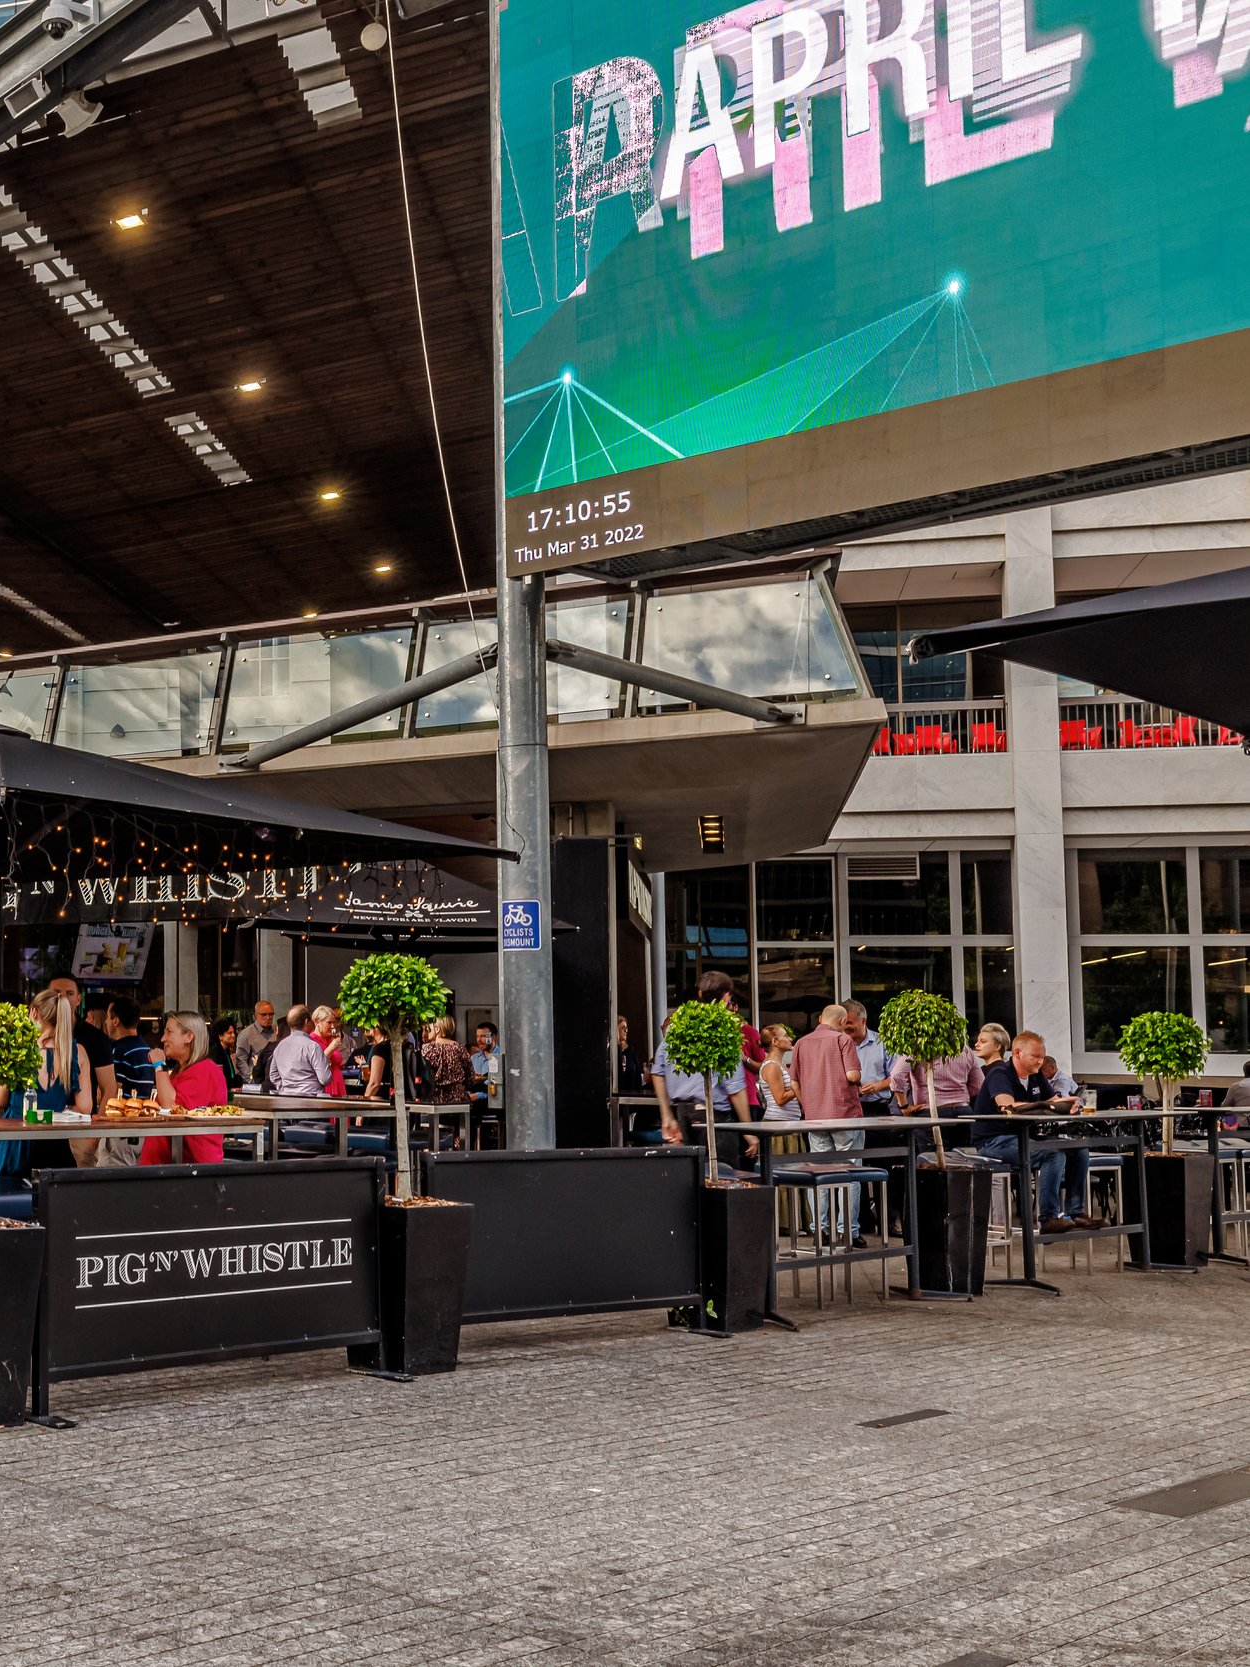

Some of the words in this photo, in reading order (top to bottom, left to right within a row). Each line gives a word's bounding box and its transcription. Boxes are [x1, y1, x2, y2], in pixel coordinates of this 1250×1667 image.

[527, 490, 631, 533] 17:10:55
[514, 546, 543, 563] Thu
[547, 540, 576, 557] Mar
[580, 533, 599, 550] 31
[604, 523, 645, 546] 2022
[77, 862, 362, 906] WHIST
[344, 891, 404, 910] James
[503, 927, 534, 937] CYCLISTS
[503, 937, 535, 947] DISMOUNT
